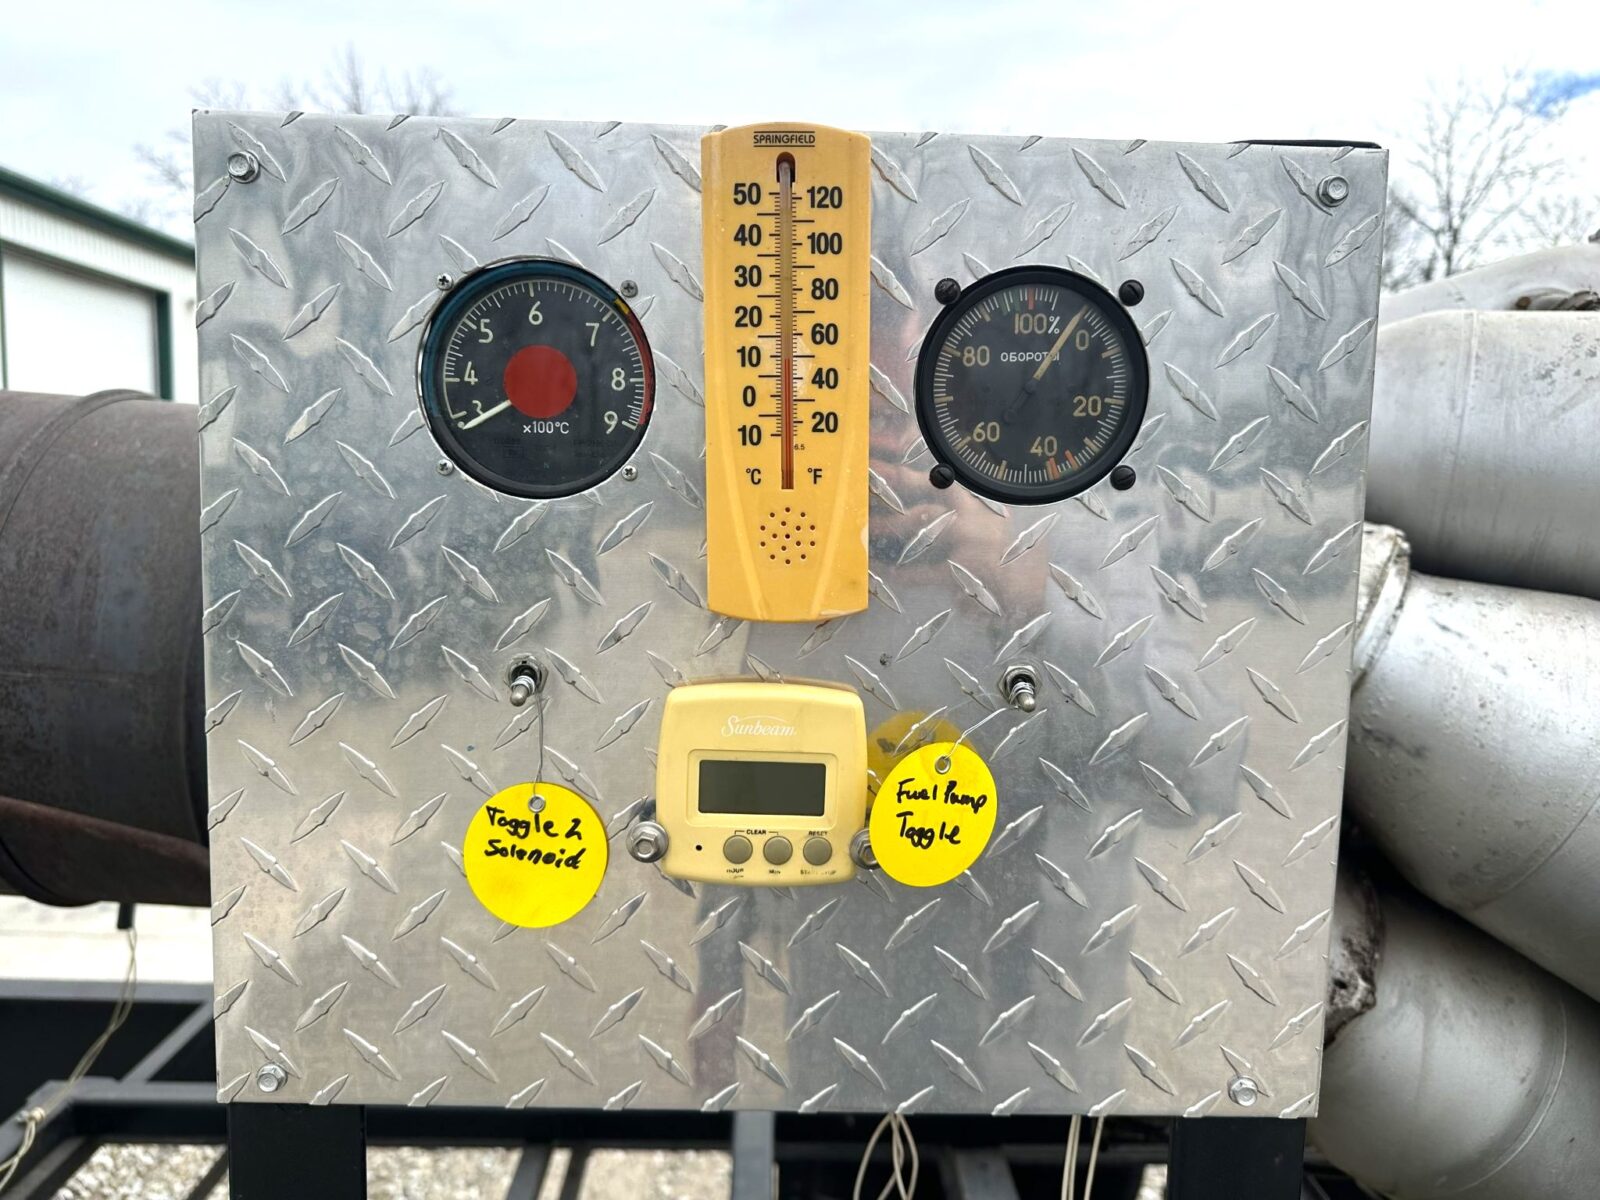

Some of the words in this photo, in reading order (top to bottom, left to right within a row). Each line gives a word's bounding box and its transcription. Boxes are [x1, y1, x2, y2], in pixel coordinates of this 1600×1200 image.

[753, 134, 815, 144] SPRINGFIELD
[733, 182, 762, 205] 50
[806, 186, 843, 209] 120
[733, 224, 762, 246] 40
[807, 232, 843, 255] 100
[734, 265, 762, 287] 30
[811, 278, 839, 300] 80
[528, 300, 543, 326] 6
[734, 306, 762, 328] 20
[478, 318, 494, 344] 5
[585, 322, 600, 347] 7
[811, 323, 839, 345] 60
[1075, 329, 1090, 351] 0
[736, 345, 762, 368] 10
[961, 345, 991, 367] 80
[464, 361, 479, 385] 4
[611, 367, 626, 391] 8
[811, 368, 839, 390] 40
[742, 385, 756, 407] 0
[1072, 395, 1102, 417] 20
[603, 410, 619, 435] 9
[811, 411, 839, 433] 20
[972, 421, 1000, 442] 60
[737, 424, 762, 446] 10
[1029, 435, 1058, 457] 40
[721, 714, 795, 738] Sunbeam
[896, 777, 938, 804] Fuel
[944, 780, 988, 814] Pump
[486, 804, 560, 840] Toggle
[564, 818, 583, 841] 2
[895, 811, 962, 850] Toggle
[484, 838, 587, 870] Solenoid
